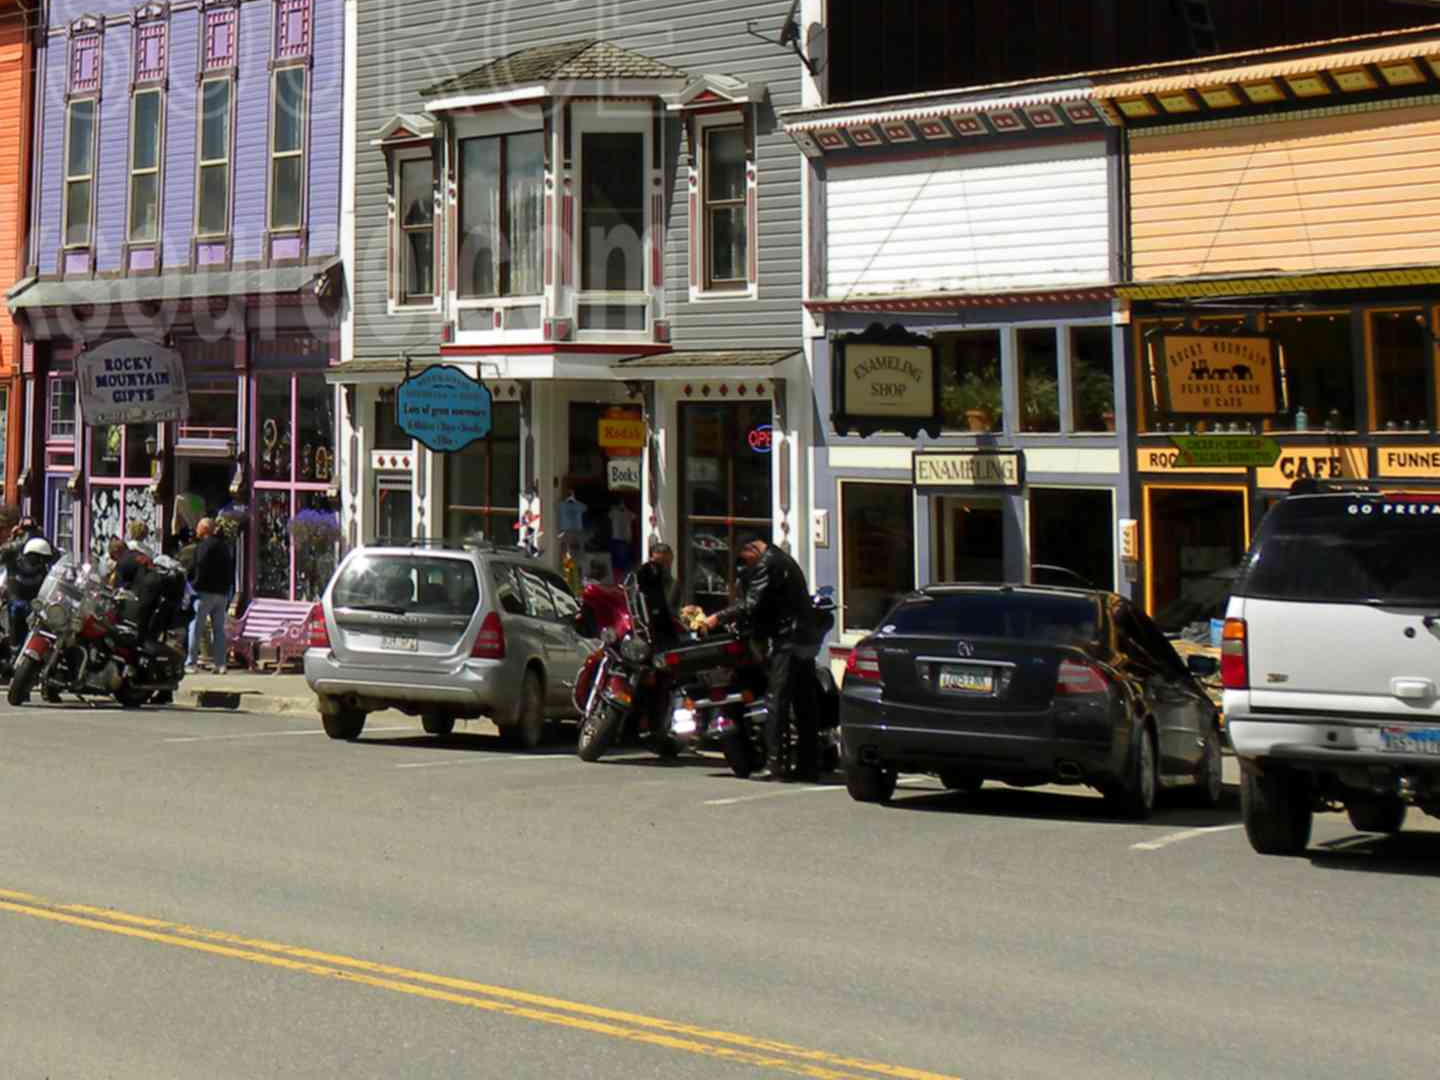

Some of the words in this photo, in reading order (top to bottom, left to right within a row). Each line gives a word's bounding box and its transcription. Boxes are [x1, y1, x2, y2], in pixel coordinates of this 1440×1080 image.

[1169, 343, 1202, 367] ROCKY
[1213, 341, 1267, 366] MOUNTAIN
[103, 357, 152, 372] ROCKY
[854, 355, 923, 384] ENAMELING
[95, 373, 170, 388] MOUNTAIN
[112, 389, 155, 403] GIFTS
[871, 383, 907, 398] SHOP
[612, 466, 640, 482] Books
[918, 460, 1015, 480] ENAMELING
[1280, 456, 1343, 480] CAFE
[1347, 504, 1373, 515] GO
